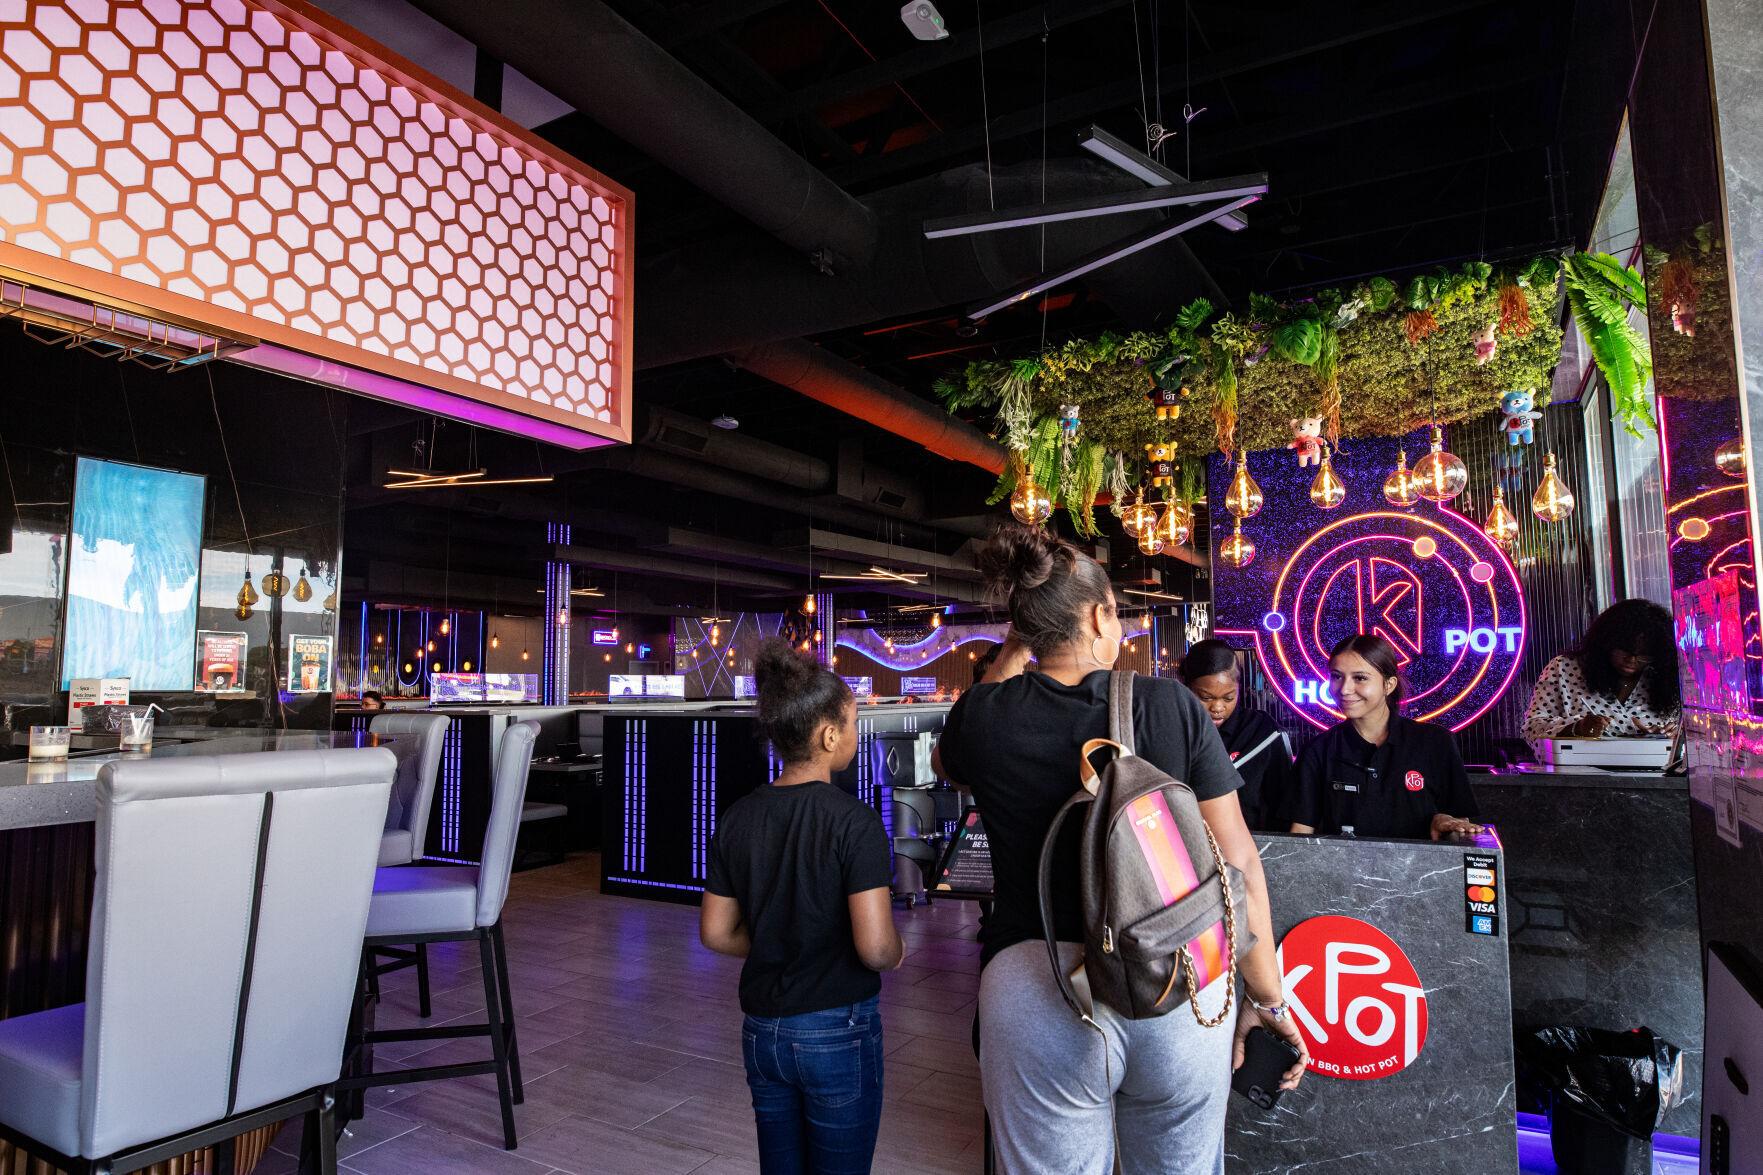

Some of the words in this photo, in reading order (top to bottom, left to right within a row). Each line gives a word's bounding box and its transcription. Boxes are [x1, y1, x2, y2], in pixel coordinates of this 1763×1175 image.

[1445, 627, 1522, 653] POT
[296, 644, 327, 653] BOBA
[302, 653, 320, 661] ON
[1468, 902, 1495, 913] VISA
[1318, 1060, 1340, 1074] BBQ
[1343, 1065, 1351, 1074] &
[1354, 1063, 1376, 1074] HOT
[1380, 1056, 1399, 1069] POT
